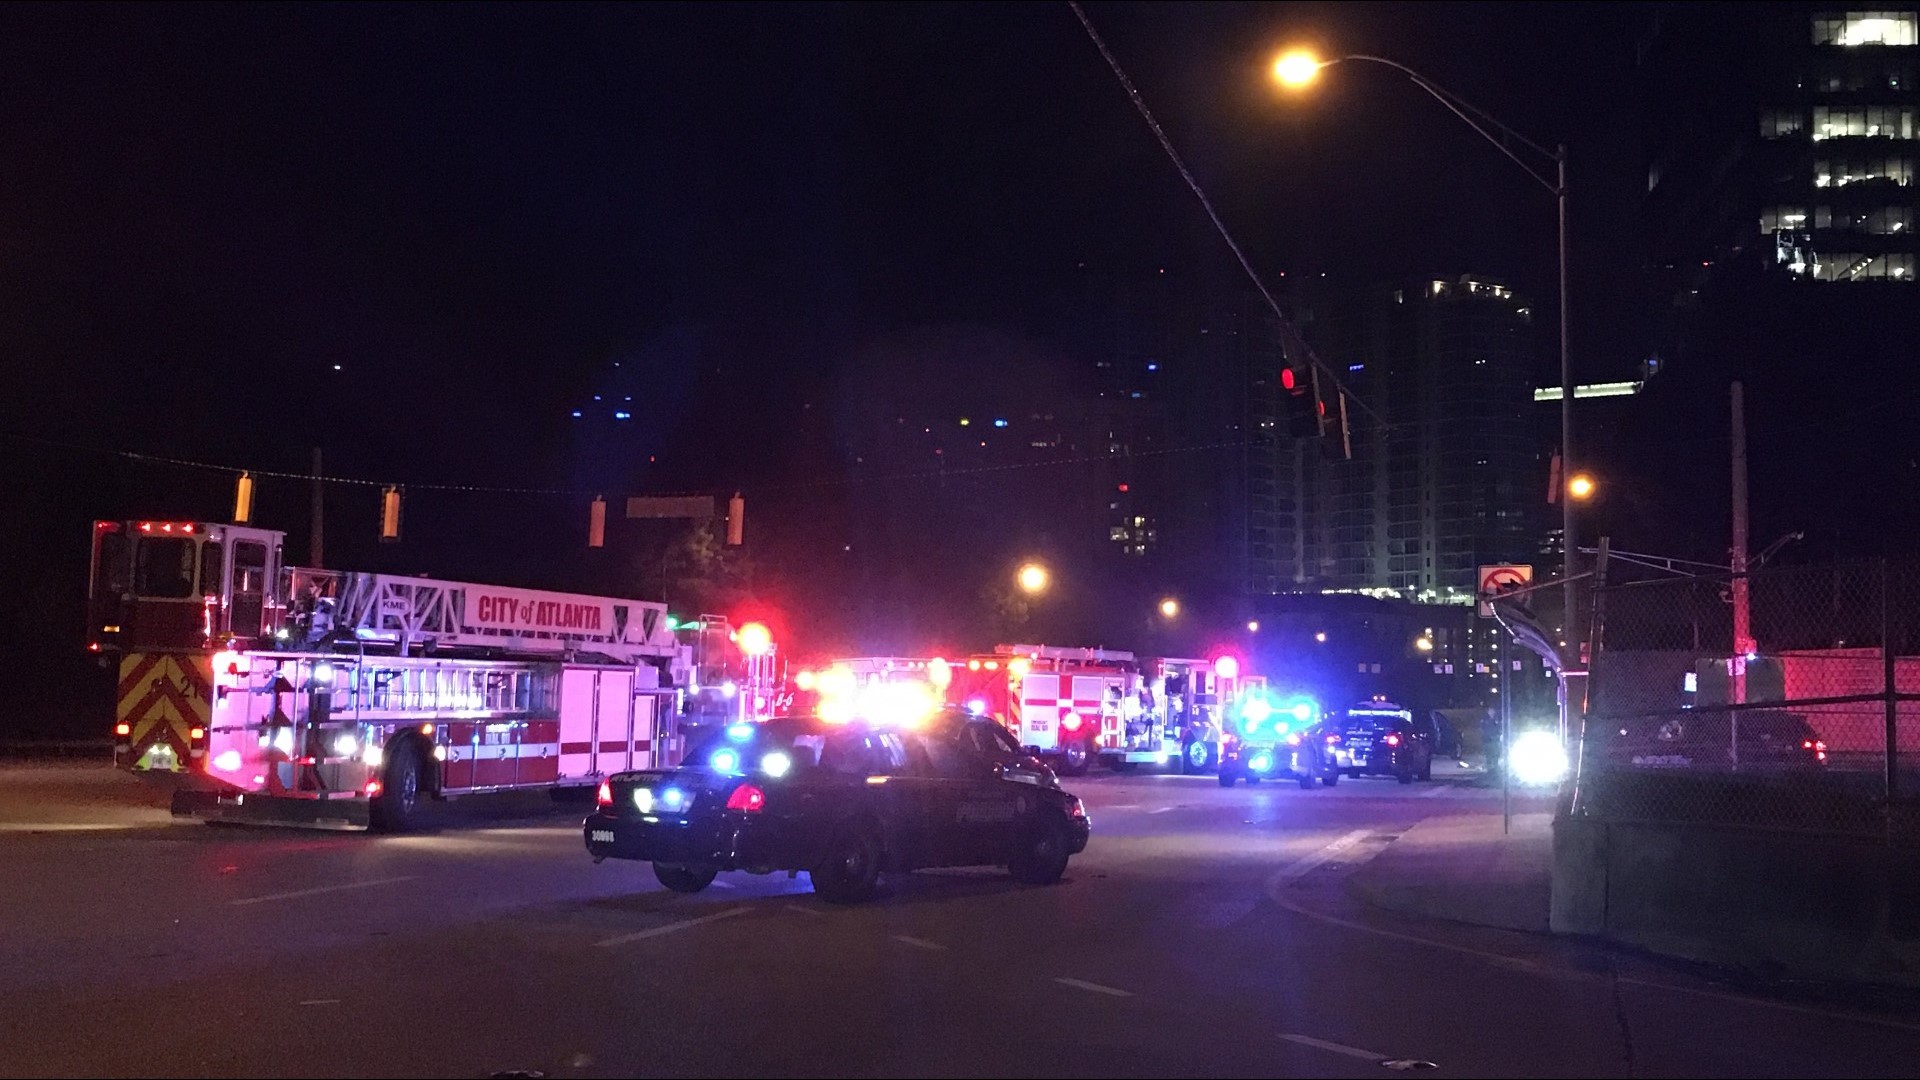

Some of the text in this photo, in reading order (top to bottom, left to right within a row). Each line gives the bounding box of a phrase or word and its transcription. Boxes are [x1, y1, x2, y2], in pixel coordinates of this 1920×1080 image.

[383, 600, 405, 610] KME
[478, 595, 601, 630] CITY of ATLANTA
[775, 692, 795, 707] B-6
